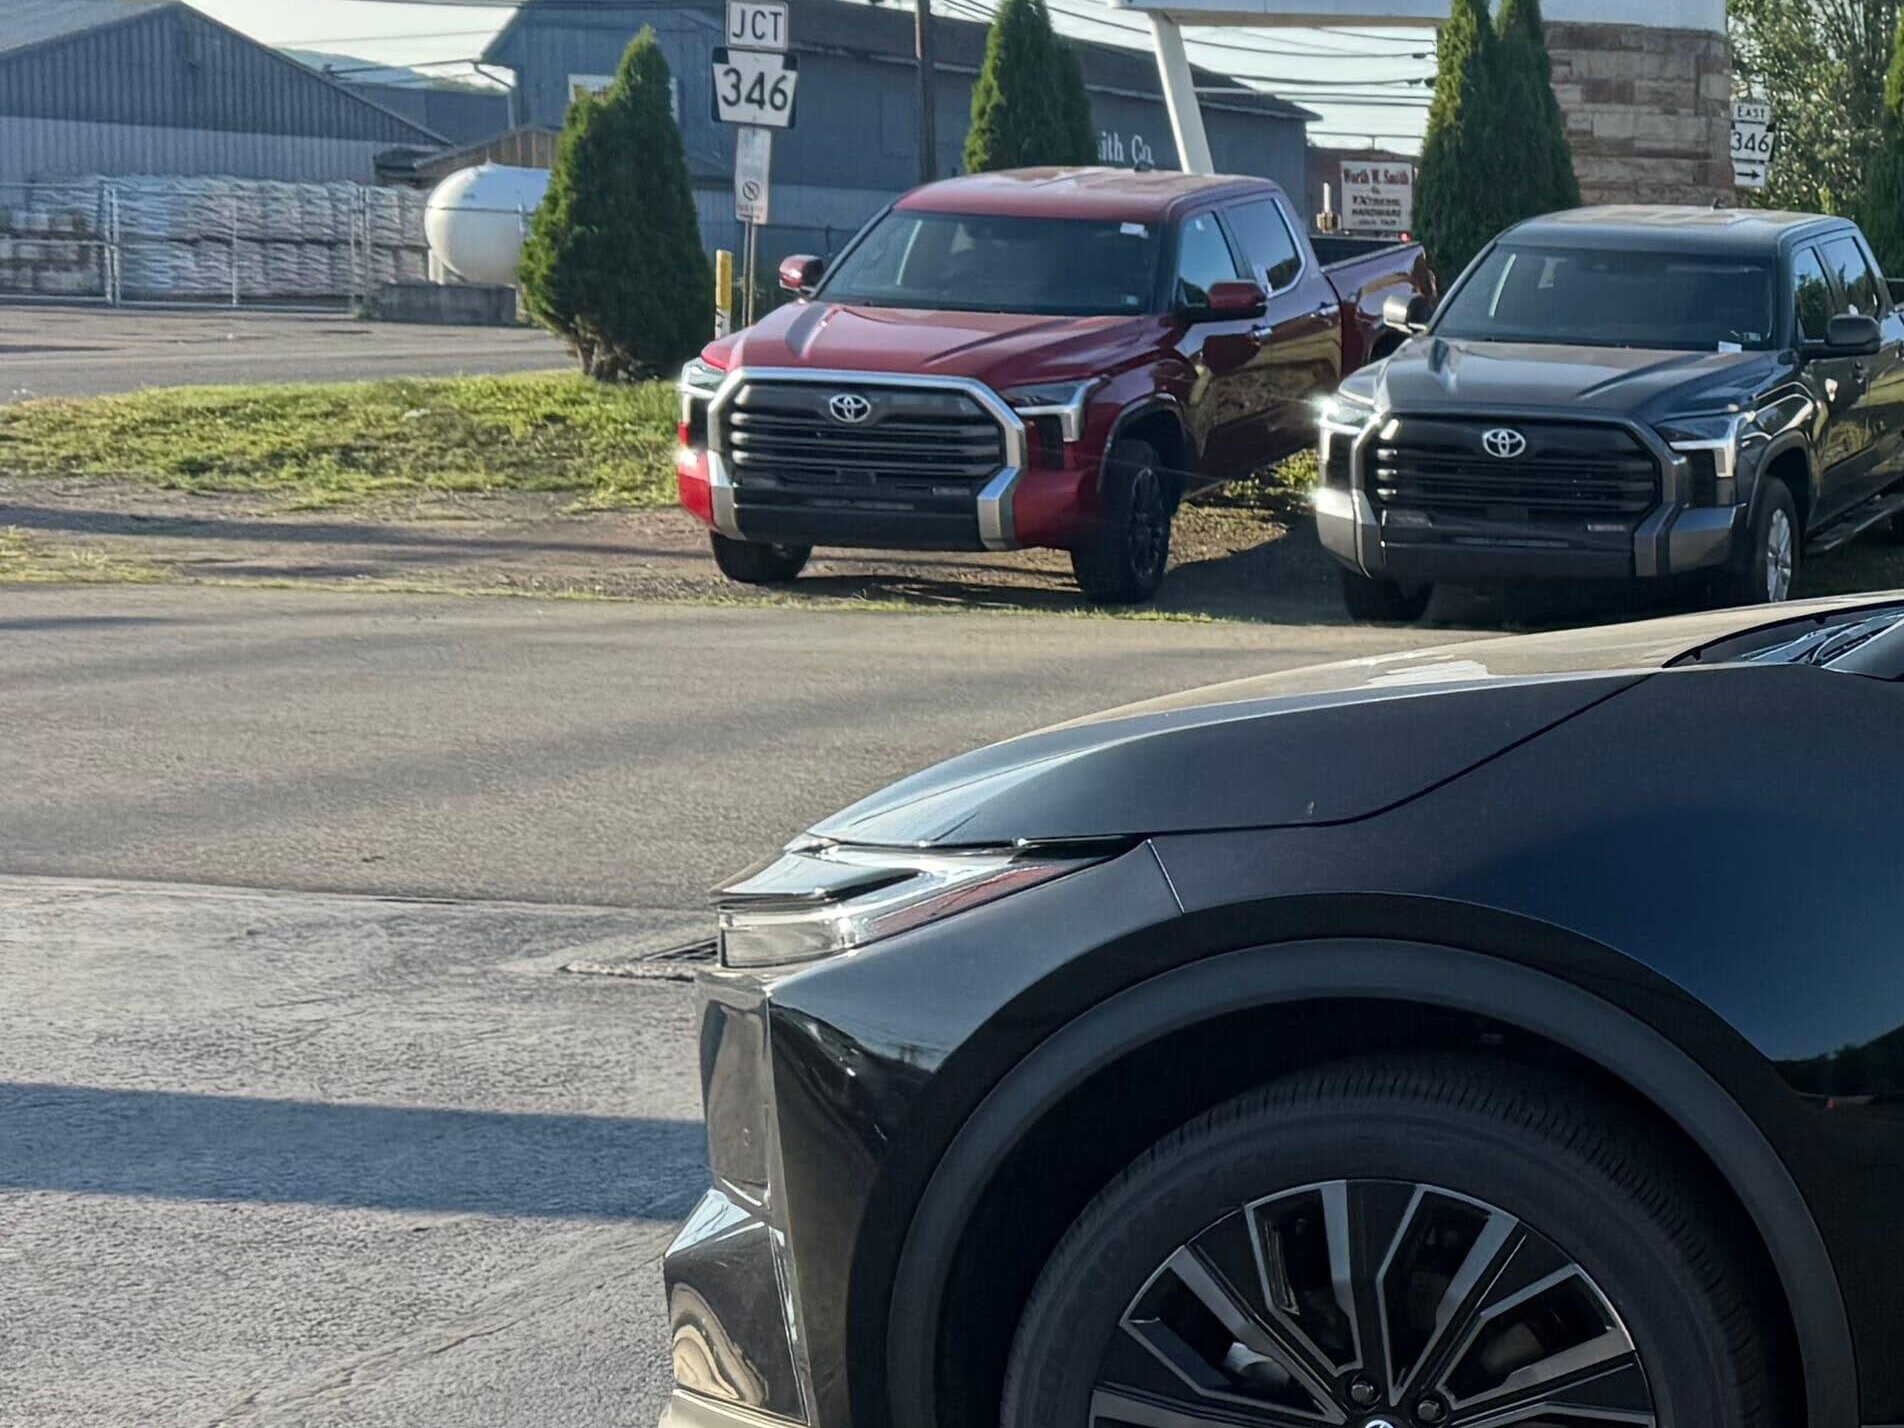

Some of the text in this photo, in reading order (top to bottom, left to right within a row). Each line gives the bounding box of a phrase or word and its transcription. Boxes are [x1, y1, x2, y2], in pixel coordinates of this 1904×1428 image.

[732, 9, 782, 42] JCT
[721, 68, 788, 112] 346
[1737, 105, 1765, 118] EAST
[1097, 131, 1124, 163] ith
[1731, 132, 1770, 152] 346
